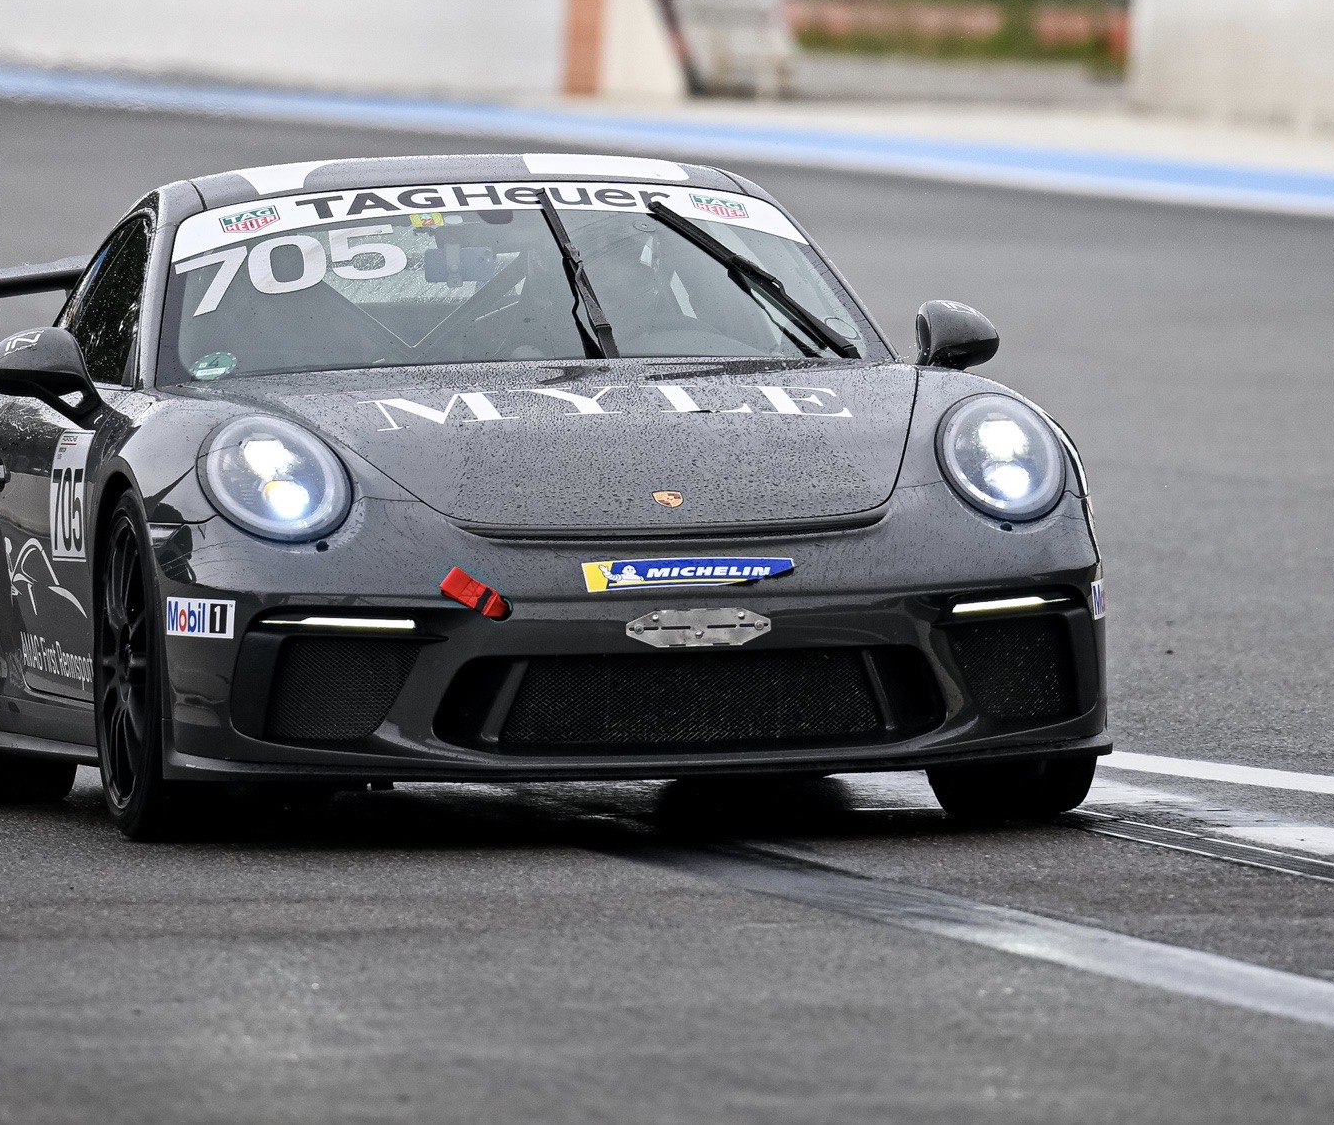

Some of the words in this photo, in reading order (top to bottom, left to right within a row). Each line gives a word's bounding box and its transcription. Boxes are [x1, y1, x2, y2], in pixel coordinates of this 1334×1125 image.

[694, 195, 743, 210] TAG
[224, 207, 273, 223] TAG
[226, 215, 277, 231] HEUER
[175, 224, 407, 317] 705
[208, 356, 220, 368] 4
[357, 385, 854, 432] MYLE
[53, 467, 84, 552] 705
[646, 566, 771, 578] MICHELIN
[168, 600, 206, 633] Mobil
[214, 605, 221, 632] 1
